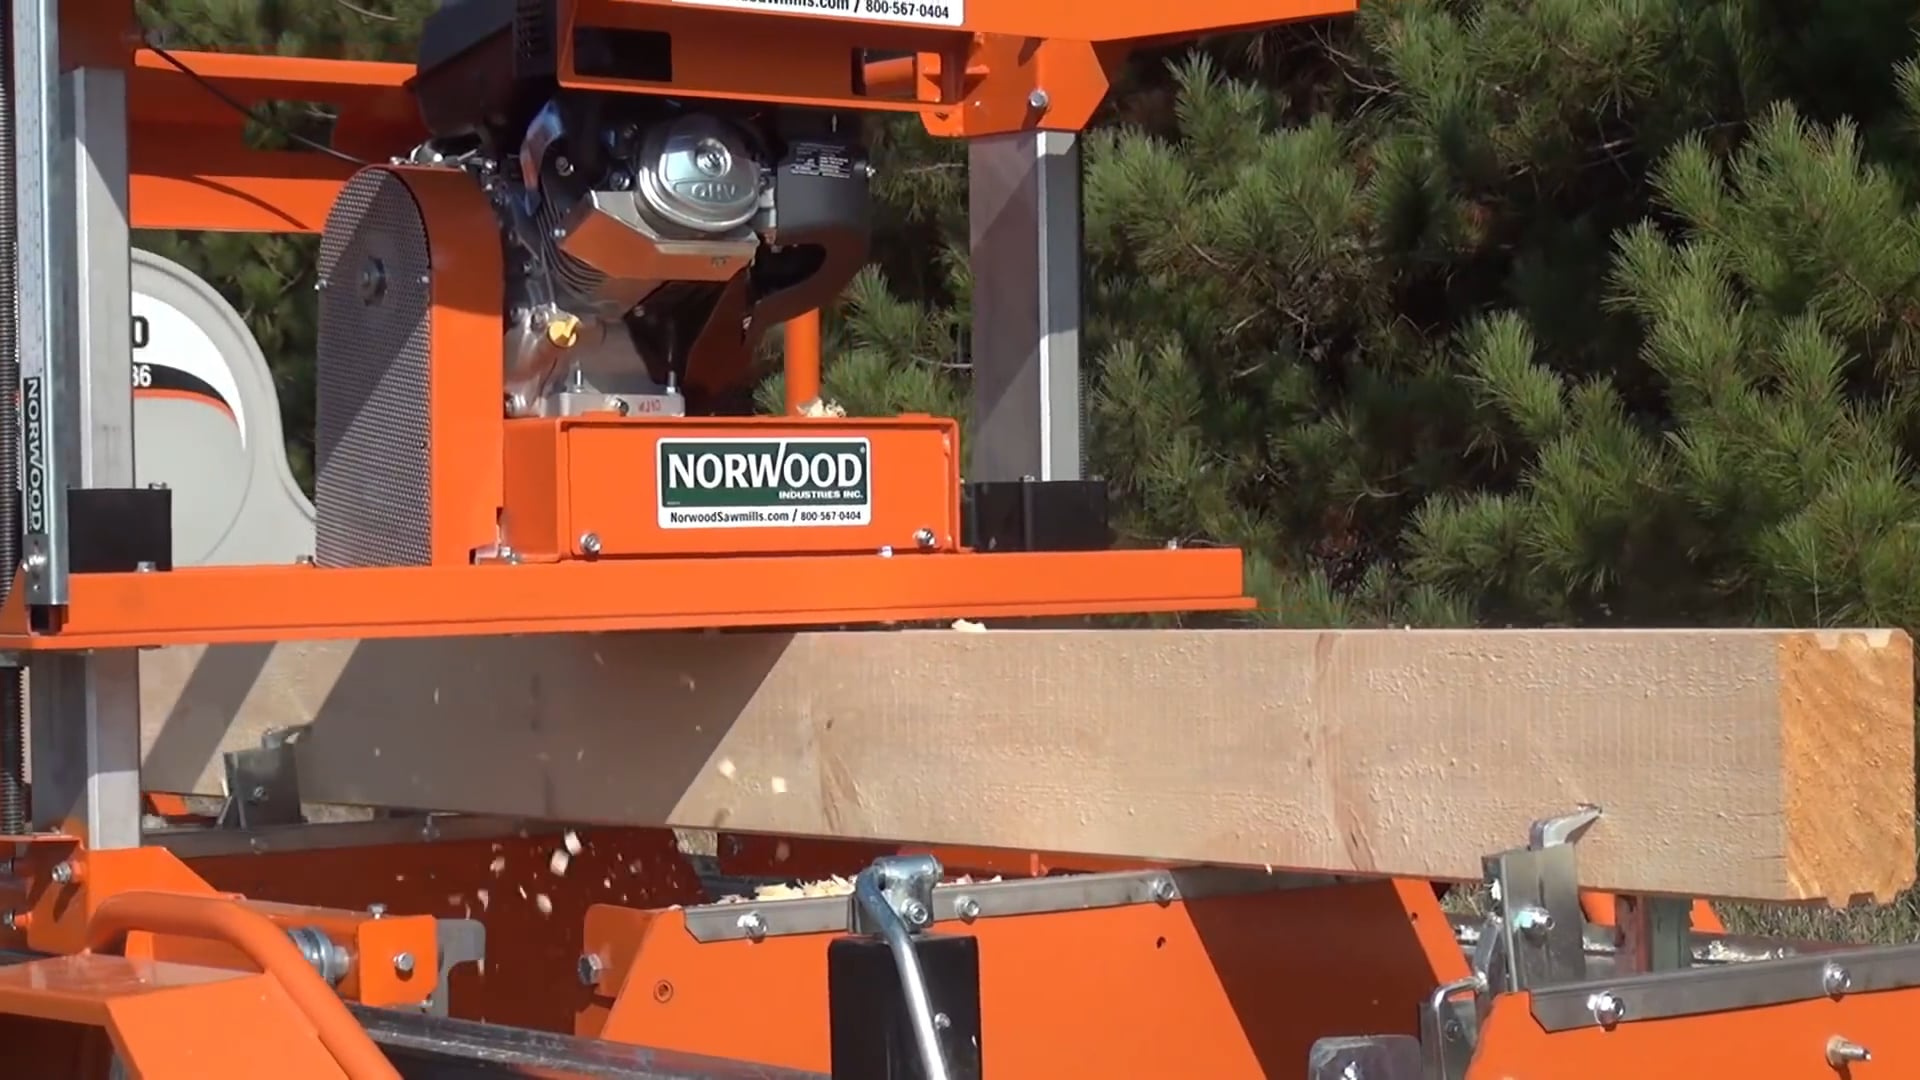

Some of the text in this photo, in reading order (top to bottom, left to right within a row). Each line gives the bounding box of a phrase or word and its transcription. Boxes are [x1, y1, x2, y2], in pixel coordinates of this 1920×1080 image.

[28, 379, 43, 531] NORWOOD
[668, 442, 863, 489] NORWOOD
[779, 490, 864, 500] INDUSTRIES INC.
[670, 510, 789, 523] NorwoodSawmills.com
